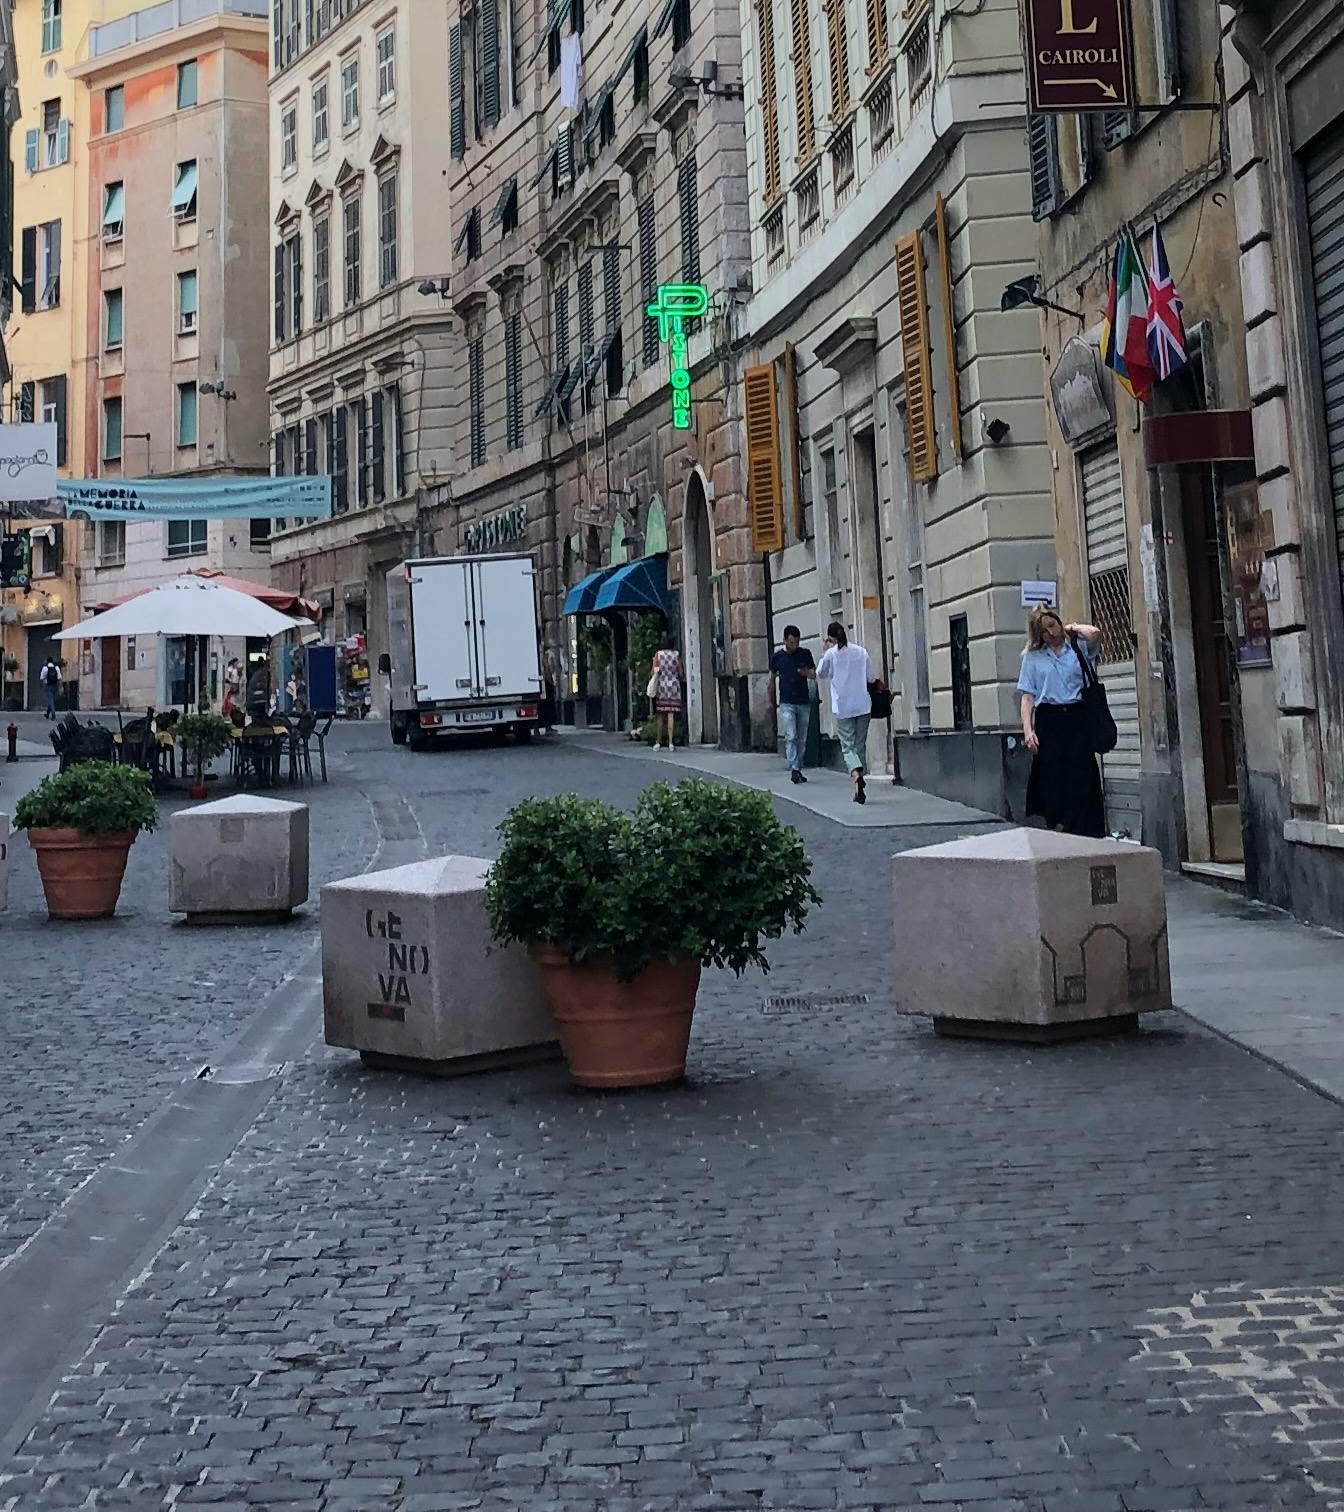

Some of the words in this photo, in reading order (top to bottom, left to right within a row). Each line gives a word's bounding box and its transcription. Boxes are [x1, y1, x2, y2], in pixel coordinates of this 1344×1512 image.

[1038, 48, 1119, 65] CAIROLI
[647, 285, 708, 429] PISTONE
[79, 488, 138, 499] MEMORIA
[95, 500, 146, 510] GUERRA
[365, 908, 402, 939] GE
[388, 943, 430, 975] NO
[377, 972, 412, 1006] VA
